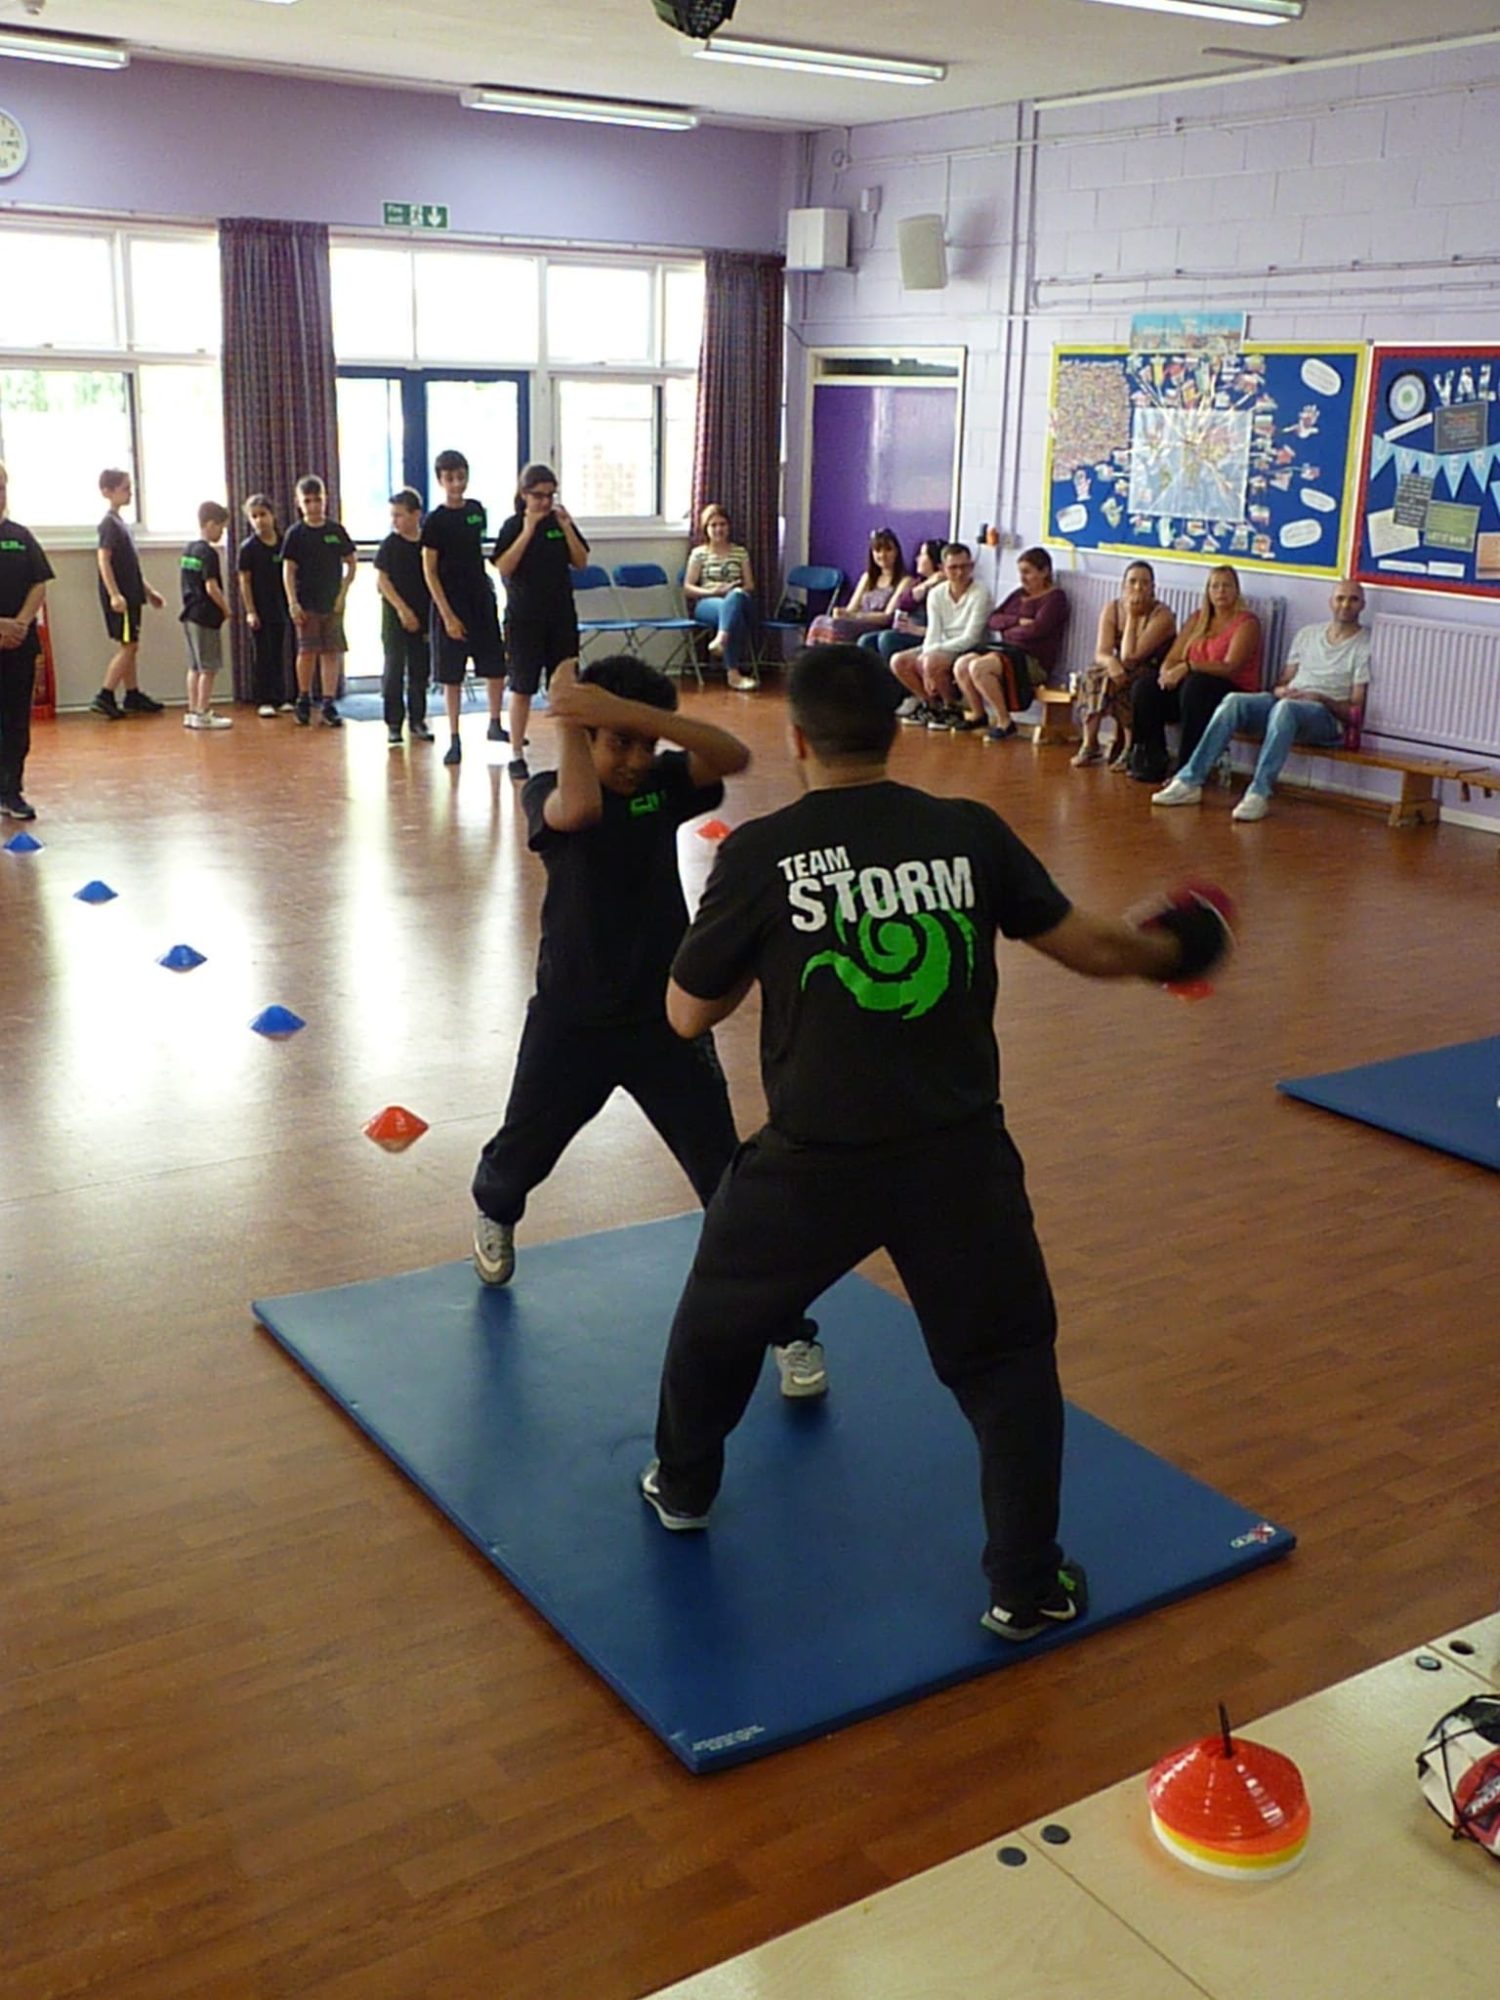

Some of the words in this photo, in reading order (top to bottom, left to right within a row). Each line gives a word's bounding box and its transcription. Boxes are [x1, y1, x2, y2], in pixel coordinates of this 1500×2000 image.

[1433, 364, 1500, 407] VAL
[777, 846, 850, 881] TEAM
[788, 857, 975, 932] STORM
